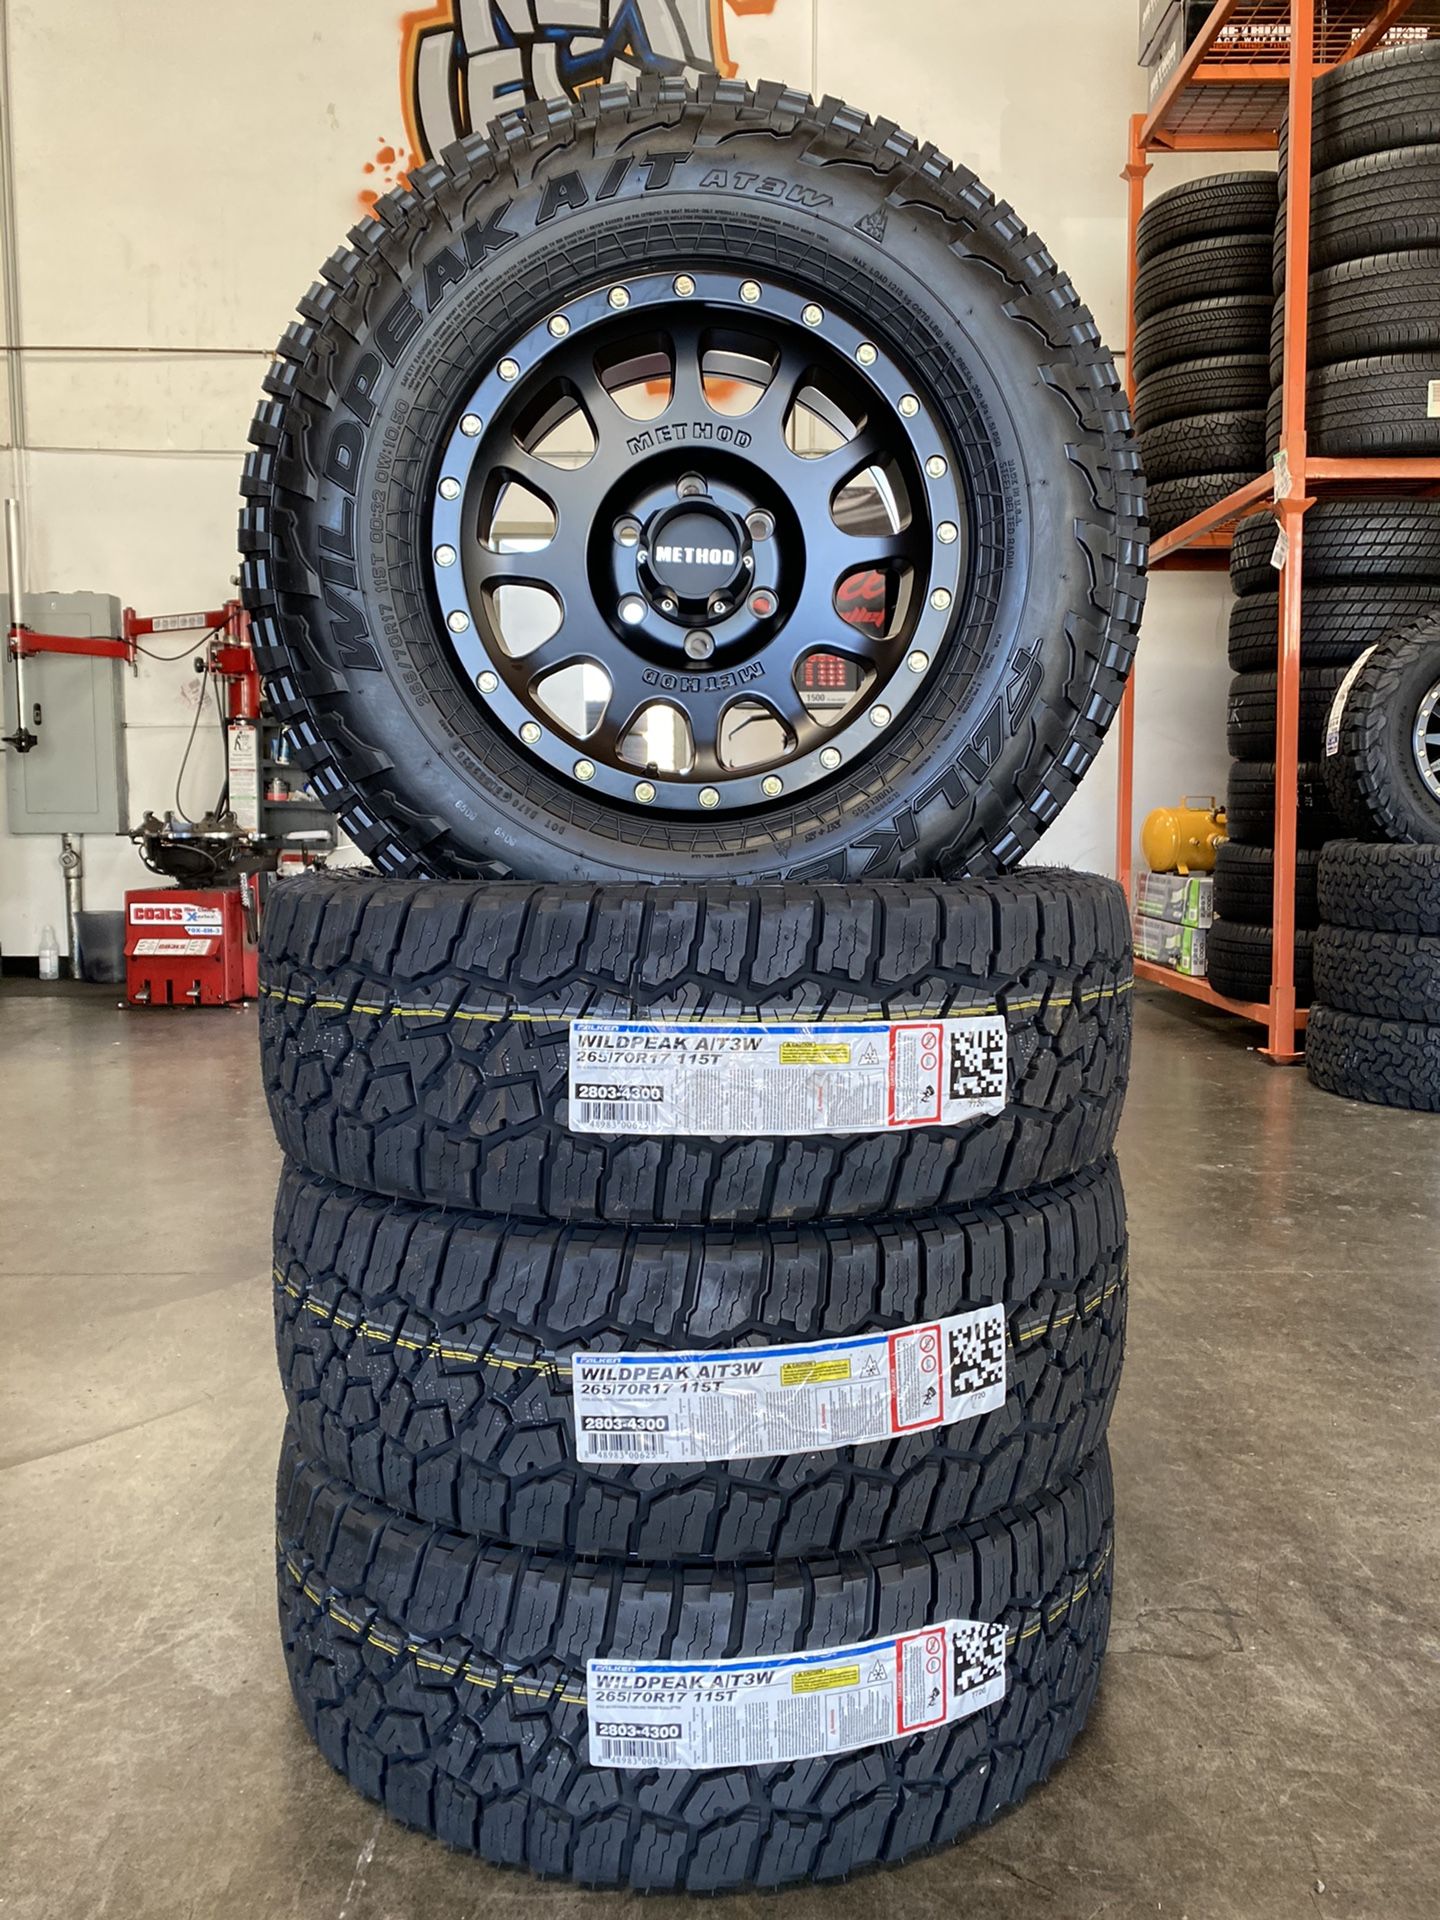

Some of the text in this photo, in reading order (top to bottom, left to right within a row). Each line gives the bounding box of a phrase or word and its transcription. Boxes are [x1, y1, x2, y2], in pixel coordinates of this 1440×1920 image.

[700, 169, 833, 207] AT3W
[319, 199, 519, 672] WILDPEAK
[536, 151, 694, 226] A/T
[375, 399, 411, 484] OW:10.50
[626, 422, 753, 455] METHOD
[997, 461, 1011, 490] STEEL
[1003, 495, 1015, 533] BELTED
[656, 546, 736, 566] METHOD
[371, 553, 389, 594] 115T
[378, 603, 430, 708] 265/70R17
[641, 661, 766, 693] METHOD
[577, 1024, 620, 1032] FALKEN
[577, 1034, 764, 1052] WILDPEAK A/T3W
[576, 1051, 723, 1065] 265/70R17 115T
[578, 1085, 661, 1101] 2803-4300
[579, 1357, 622, 1365] FALKEN
[581, 1365, 691, 1381] WILDPEAK
[696, 1361, 764, 1379] A/T3W
[581, 1380, 724, 1395] 265/70R17 115T
[584, 1417, 666, 1431] 2803-4300
[594, 1664, 636, 1672] FALKEN
[596, 1675, 704, 1690] WILDPEAK
[711, 1671, 775, 1689] A/T3W
[595, 1690, 738, 1704] 265/70R17 115T
[599, 1724, 679, 1739] 2803-4300
